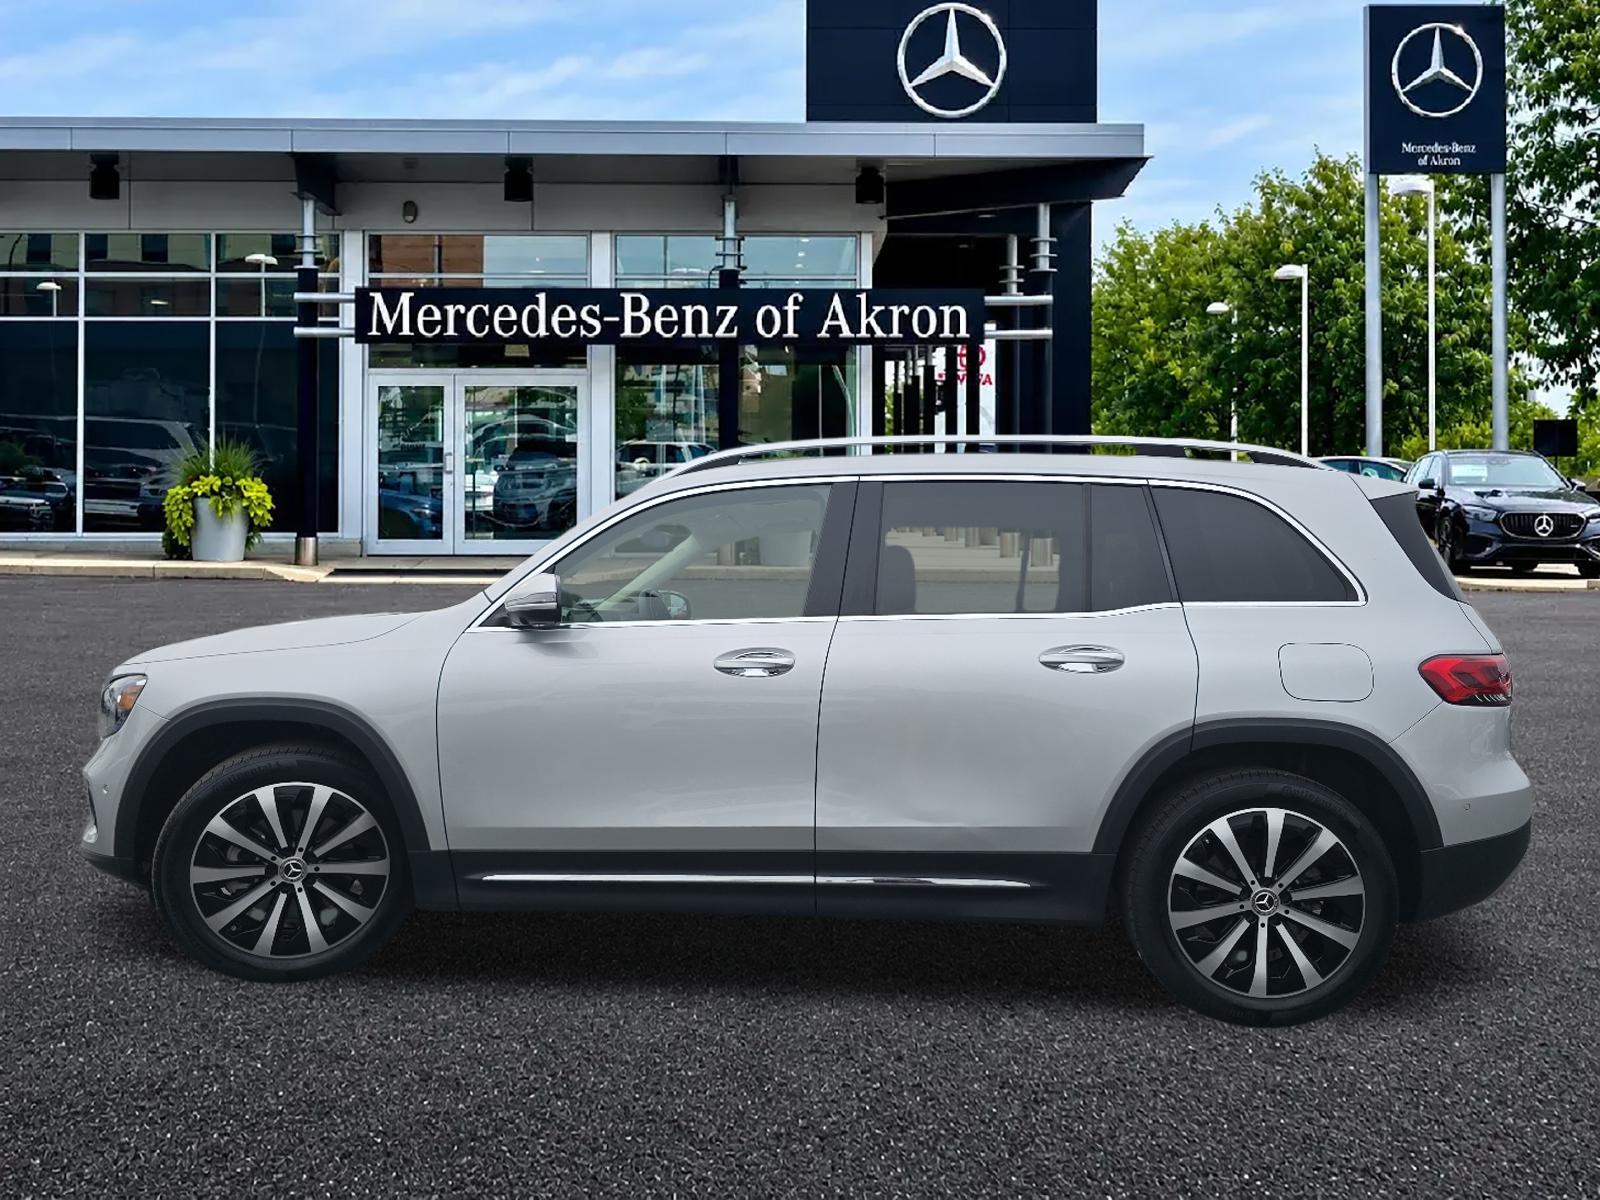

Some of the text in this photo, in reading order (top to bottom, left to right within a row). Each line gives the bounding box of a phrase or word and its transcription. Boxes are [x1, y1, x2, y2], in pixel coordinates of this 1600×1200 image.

[1401, 141, 1476, 154] Mercedes-Benz
[1417, 154, 1461, 166] of Akron
[367, 292, 970, 339] Mercedes-Benz of Akron
